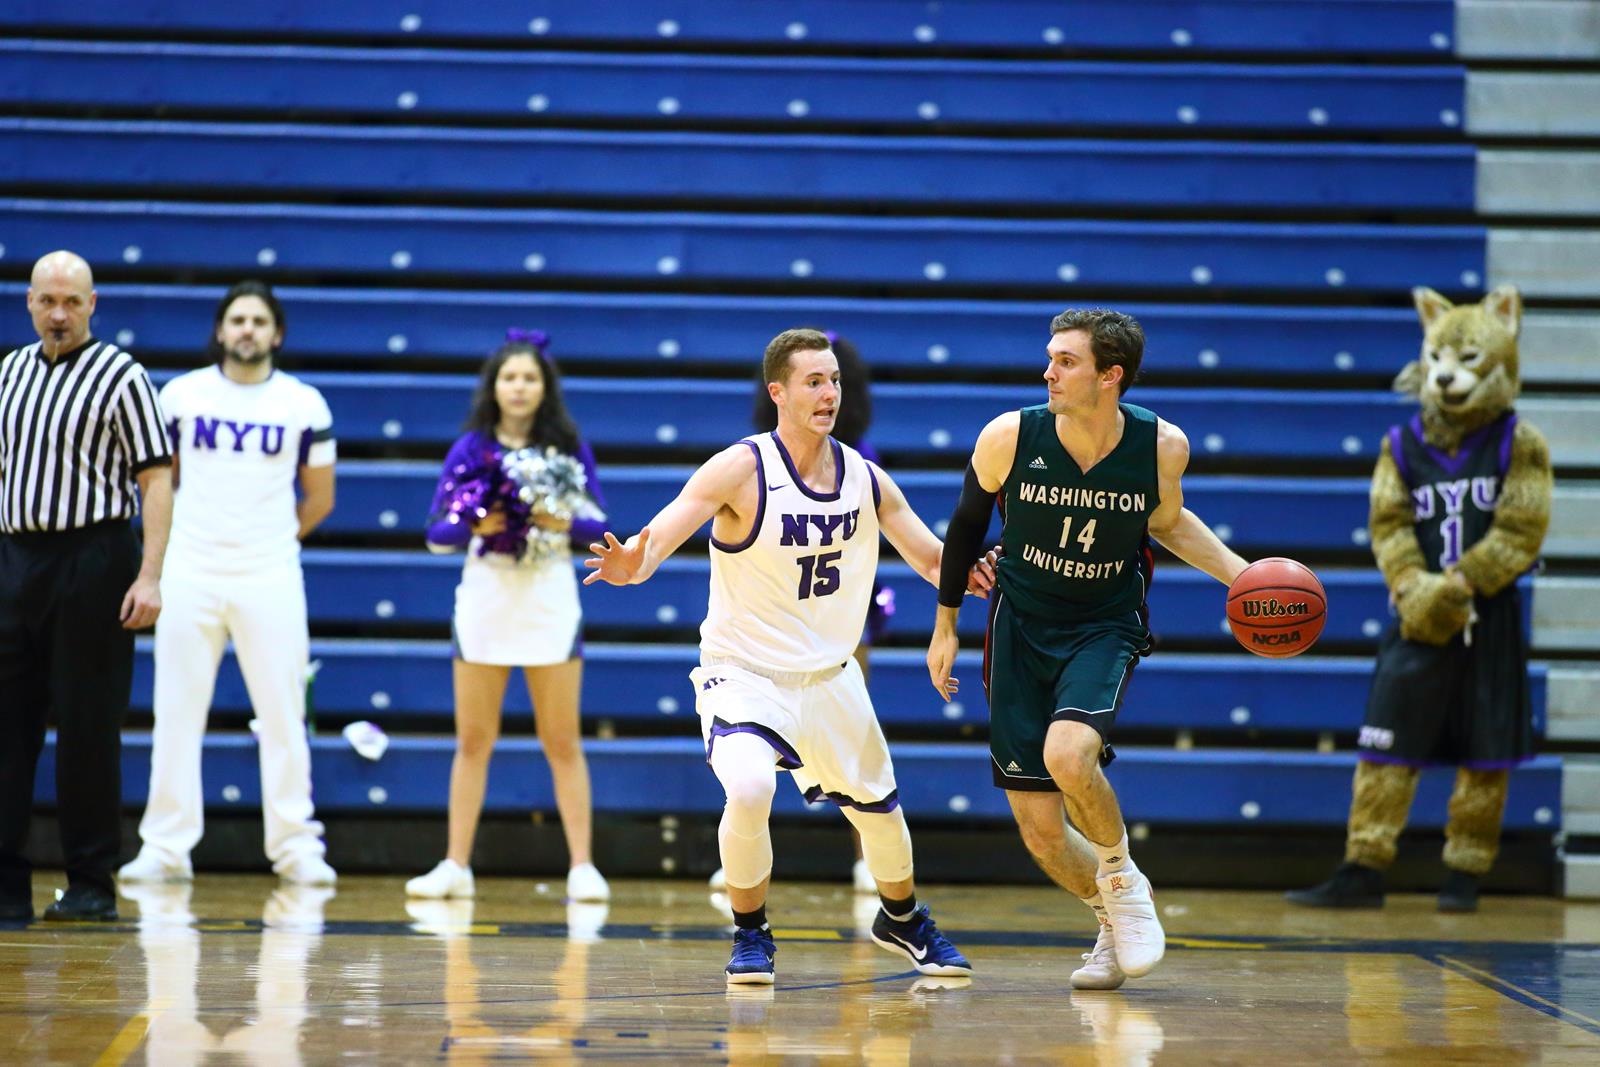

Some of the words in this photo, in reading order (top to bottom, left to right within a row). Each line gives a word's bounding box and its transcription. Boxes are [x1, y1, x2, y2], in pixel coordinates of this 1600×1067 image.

[193, 415, 285, 456] NYU
[1019, 482, 1146, 513] WASHINGTON
[1412, 477, 1498, 521] NYU
[779, 507, 861, 547] NYU
[1058, 516, 1098, 554] 14
[1439, 515, 1464, 569] 1
[796, 550, 843, 601] 15
[1022, 543, 1125, 580] UNIVERSITY
[1241, 599, 1310, 619] Wilson
[1251, 630, 1302, 646] NCAA
[703, 677, 727, 691] NY
